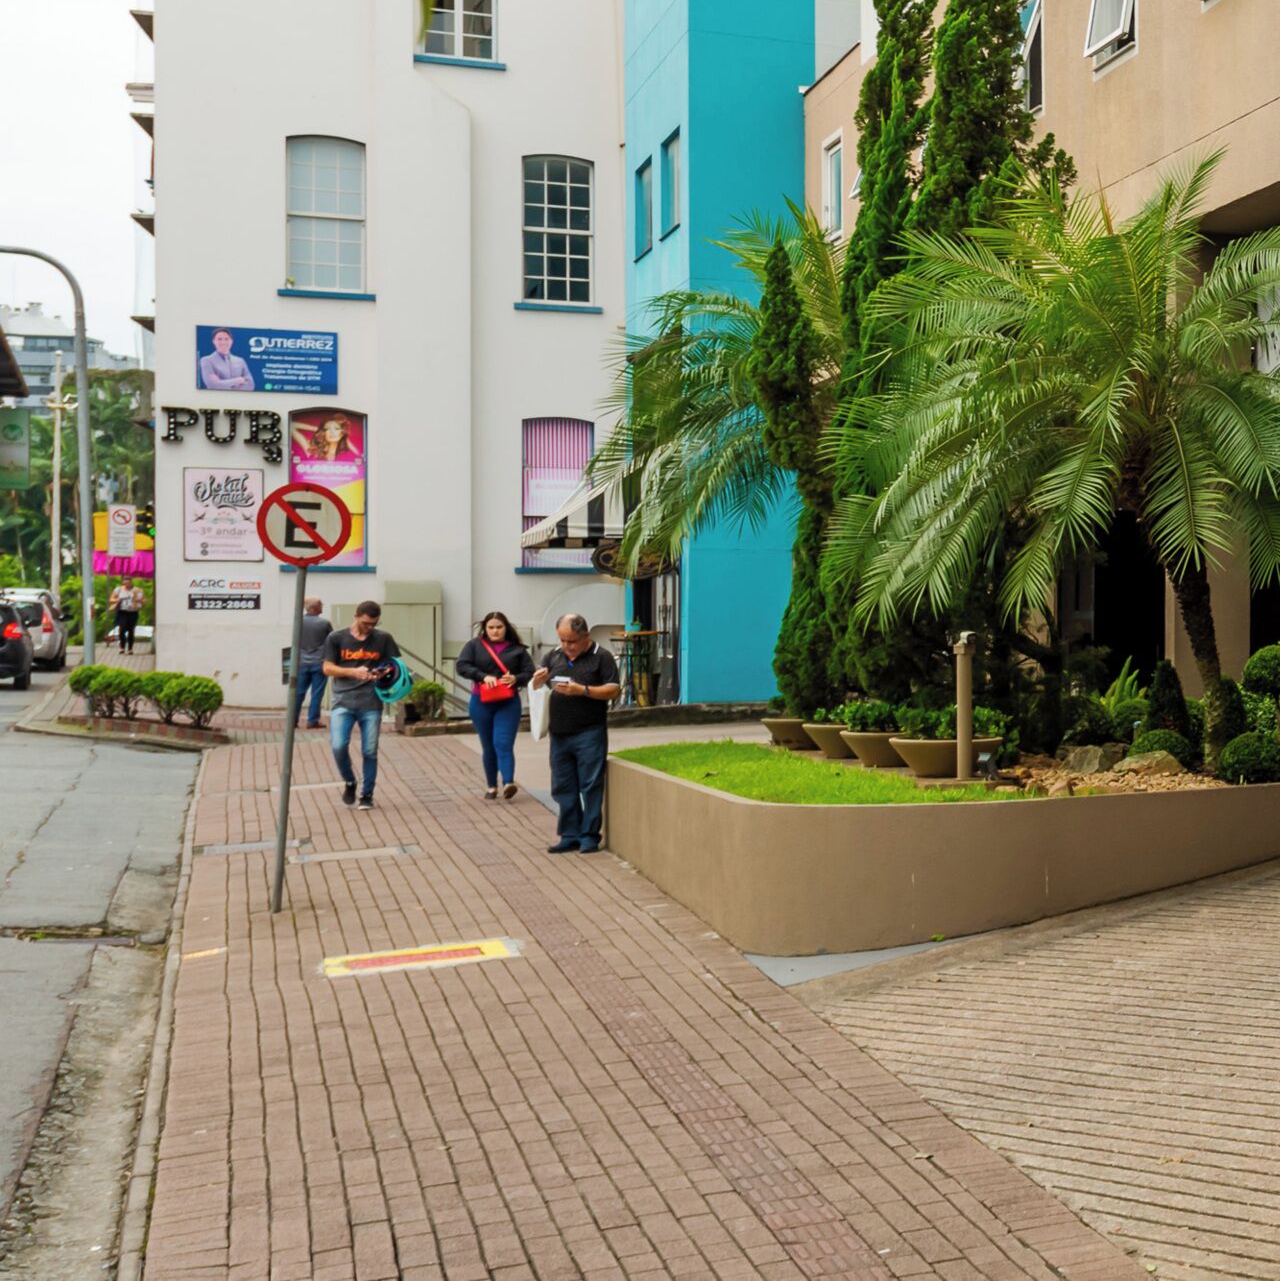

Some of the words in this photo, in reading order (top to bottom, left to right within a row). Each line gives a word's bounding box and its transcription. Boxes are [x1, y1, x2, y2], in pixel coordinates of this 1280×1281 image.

[160, 406, 283, 444] PUB
[216, 527, 248, 535] andar
[189, 579, 226, 589] ACRC
